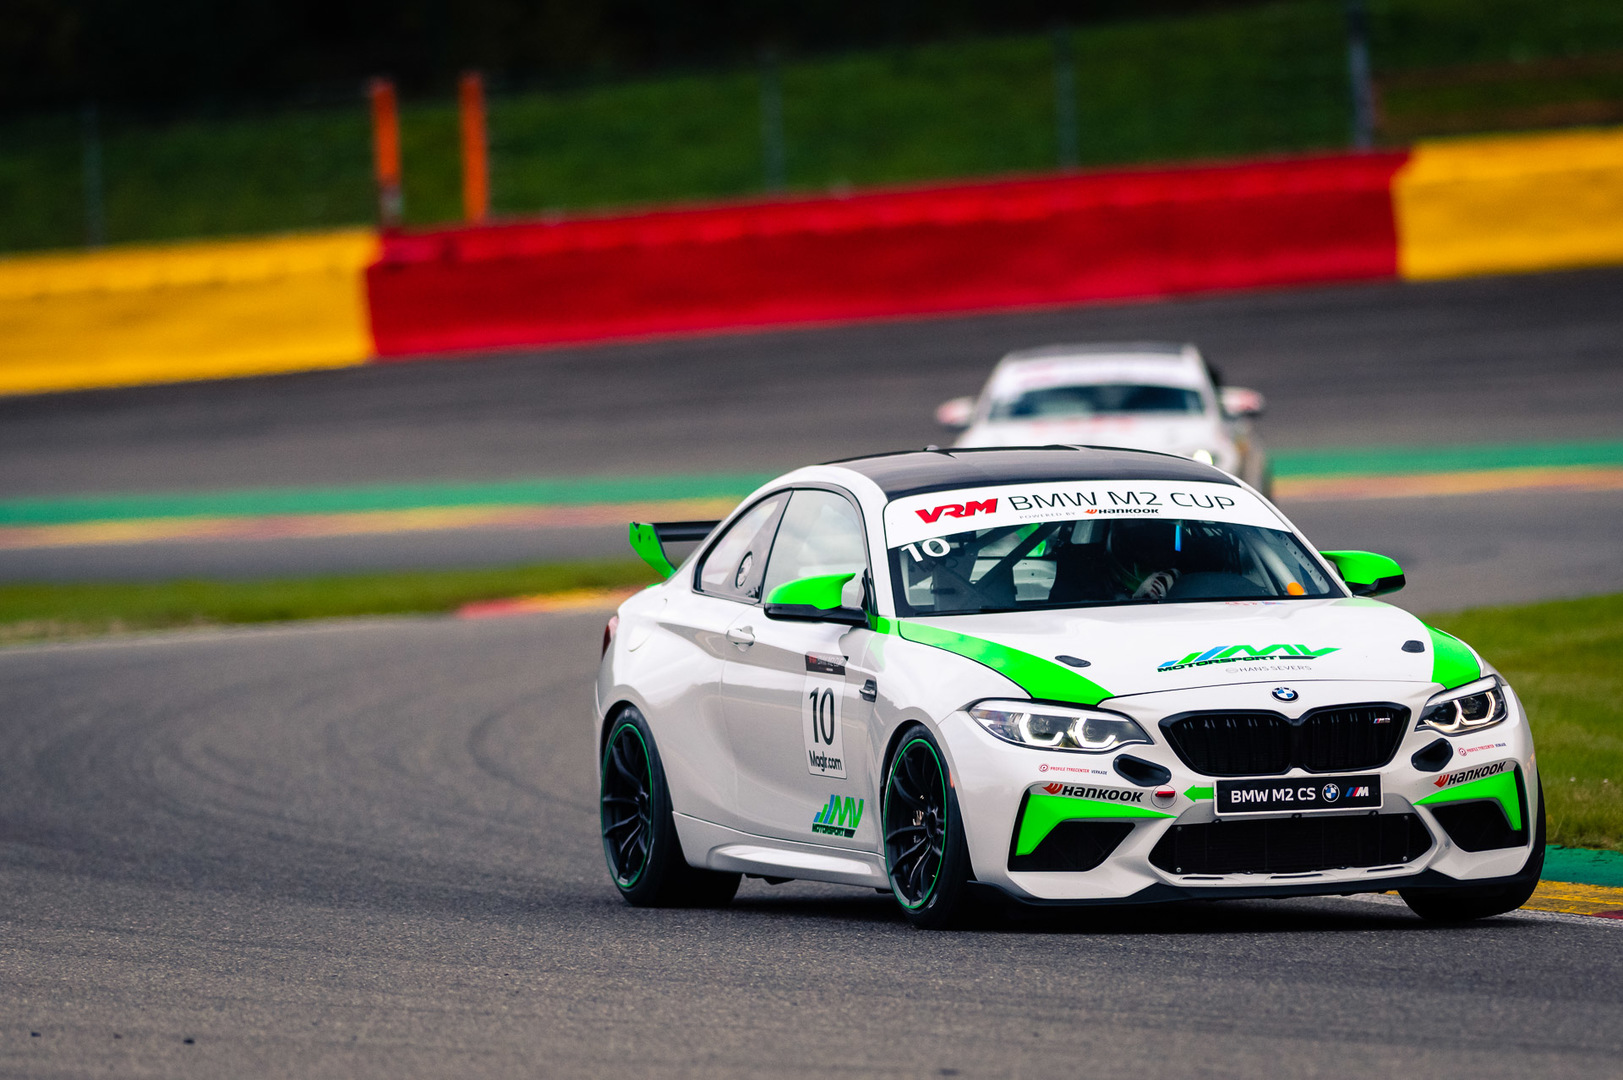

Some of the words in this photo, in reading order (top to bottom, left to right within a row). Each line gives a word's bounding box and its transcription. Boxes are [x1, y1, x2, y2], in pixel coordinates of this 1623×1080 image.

[915, 498, 998, 524] VRM
[1008, 492, 1097, 511] BMW
[1107, 491, 1163, 507] M2
[1170, 492, 1235, 509] CUP
[901, 538, 951, 563] 10
[1157, 655, 1278, 672] MOTORSPORT
[809, 687, 835, 746] 10
[1231, 789, 1269, 803] BMW
[1272, 788, 1294, 802] M2
[1297, 787, 1316, 800] CS
[812, 823, 845, 837] MOTORSPORT
